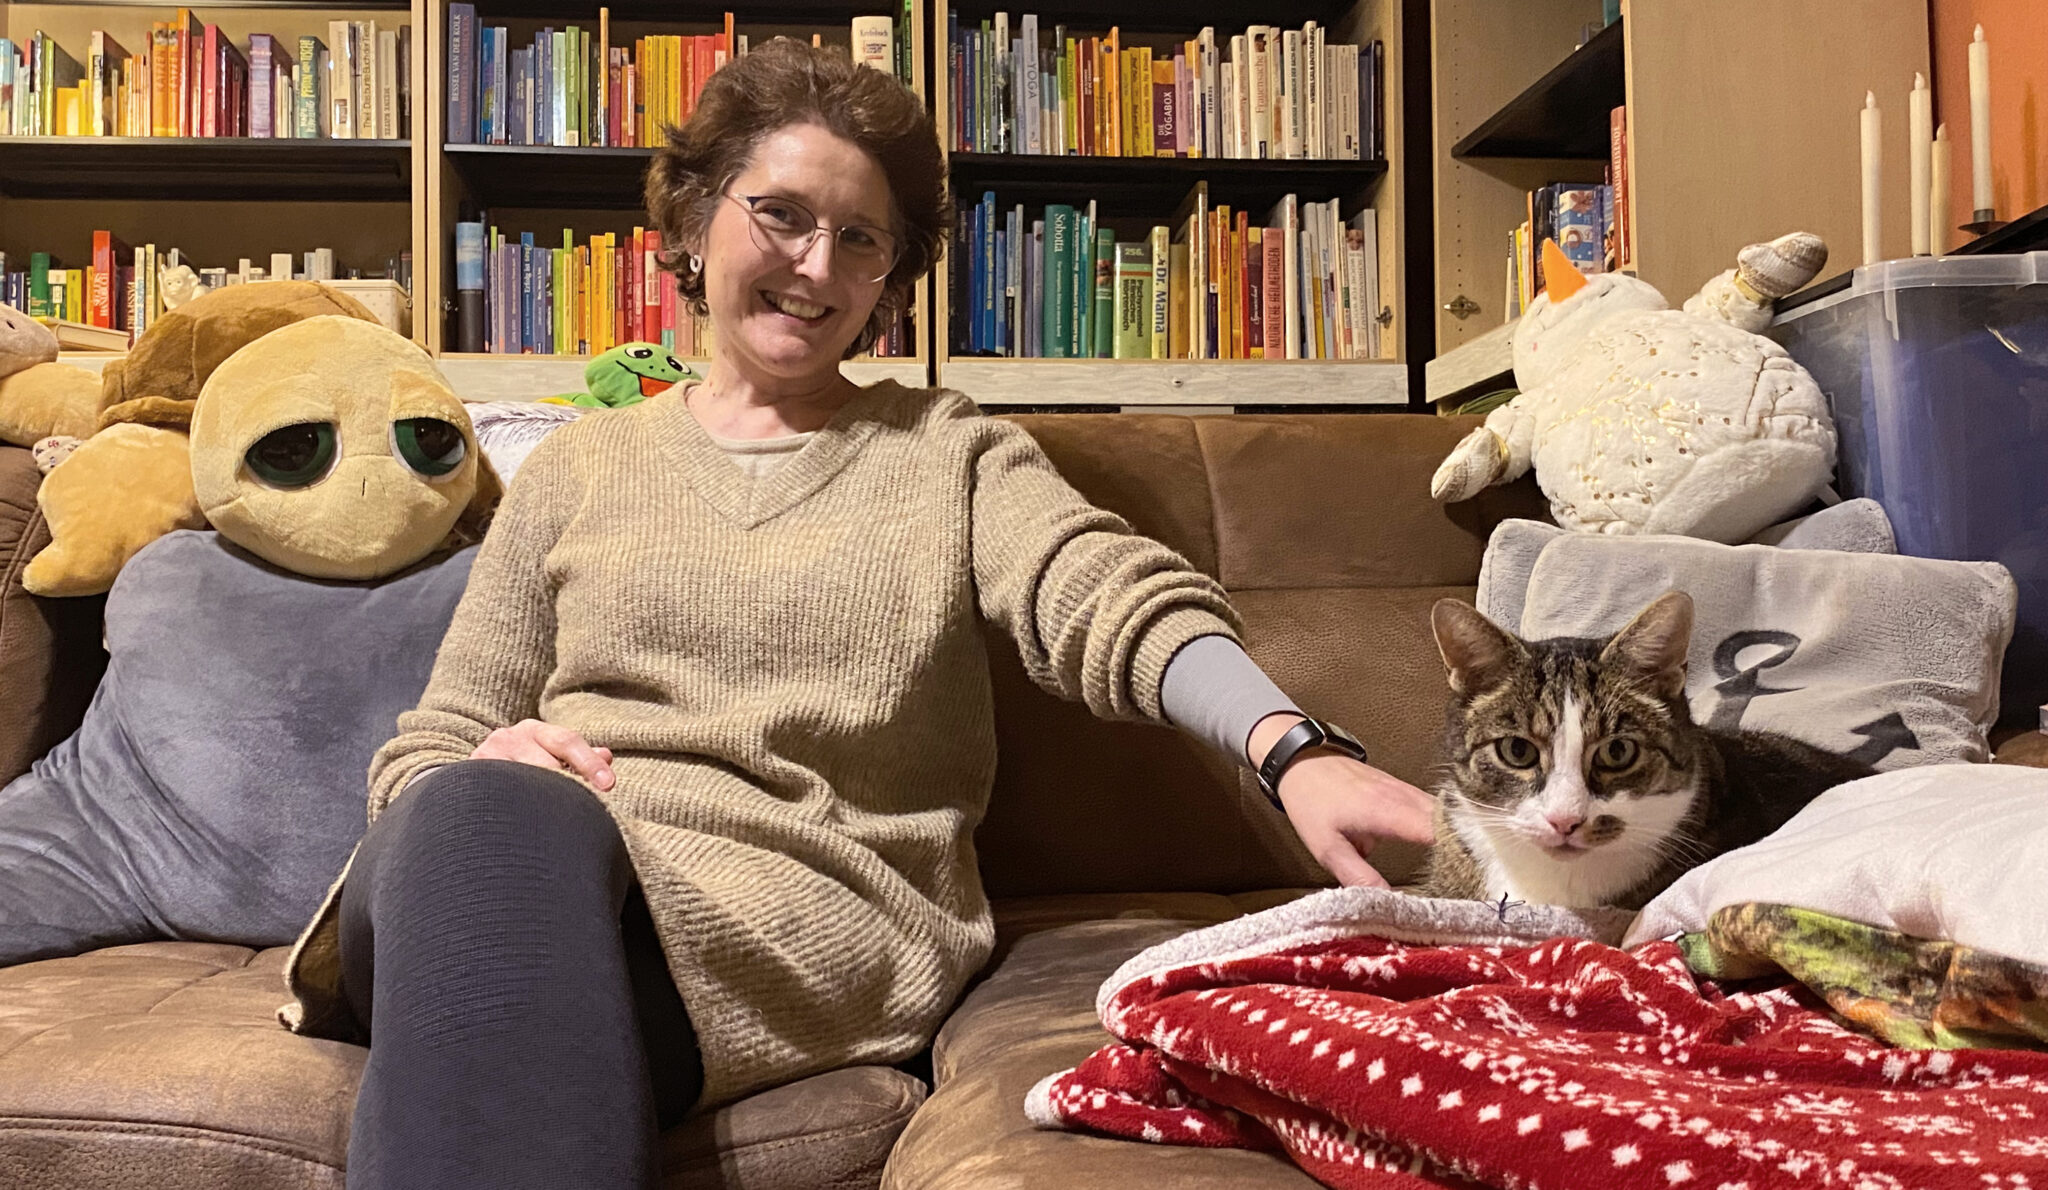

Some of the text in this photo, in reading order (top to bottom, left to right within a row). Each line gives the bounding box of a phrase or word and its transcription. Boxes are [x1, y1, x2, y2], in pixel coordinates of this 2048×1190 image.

[154, 51, 167, 93] KATZEN
[452, 54, 460, 72] VAN
[1028, 63, 1037, 99] YOGA
[452, 74, 460, 101] BESSEL
[1255, 56, 1265, 113] Frauensache
[1164, 92, 1173, 136] YOGABOX
[1054, 214, 1066, 252] Sobotta
[524, 273, 532, 293] Erfolg
[1155, 268, 1167, 333] Dr. Mama
[1266, 247, 1281, 349] NATÜRLICHE HEILMETHODEN
